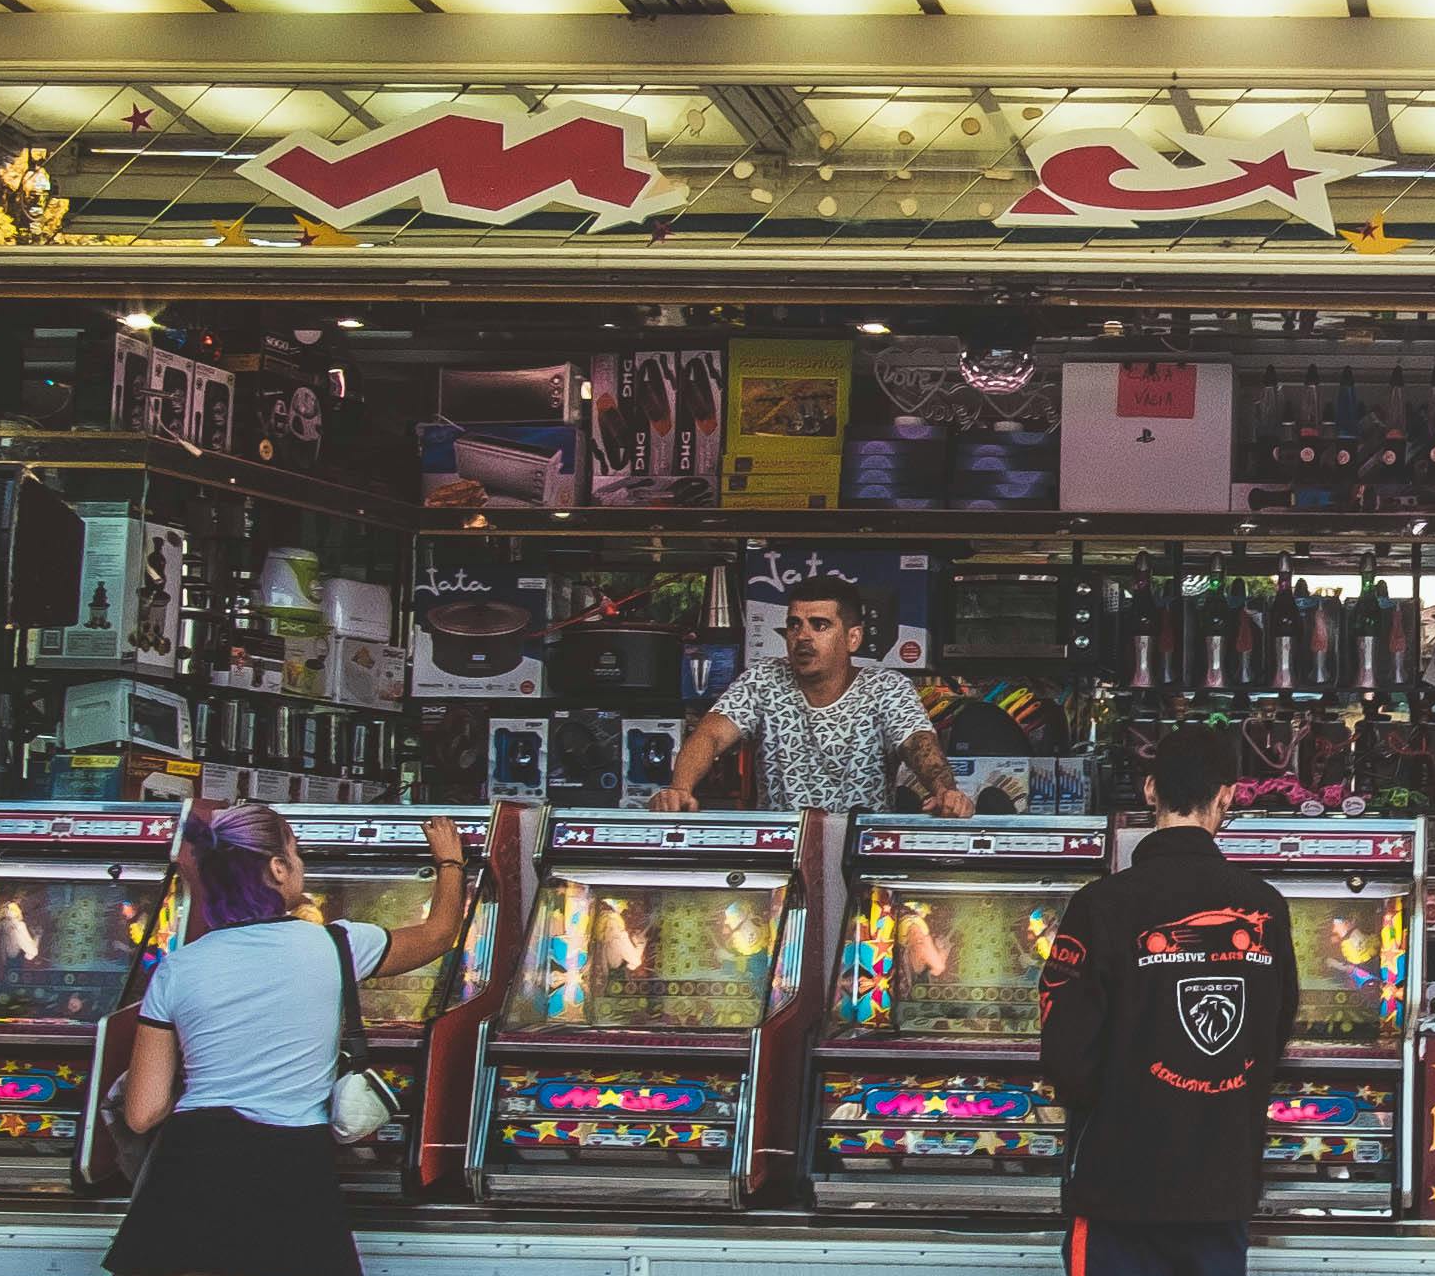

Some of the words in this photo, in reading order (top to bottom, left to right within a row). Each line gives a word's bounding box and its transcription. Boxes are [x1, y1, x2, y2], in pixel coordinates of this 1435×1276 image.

[415, 567, 492, 597] Jata
[1138, 952, 1206, 967] EXCLUSIVE
[1210, 951, 1244, 962] CARS
[1184, 984, 1239, 993] PEUGEOT
